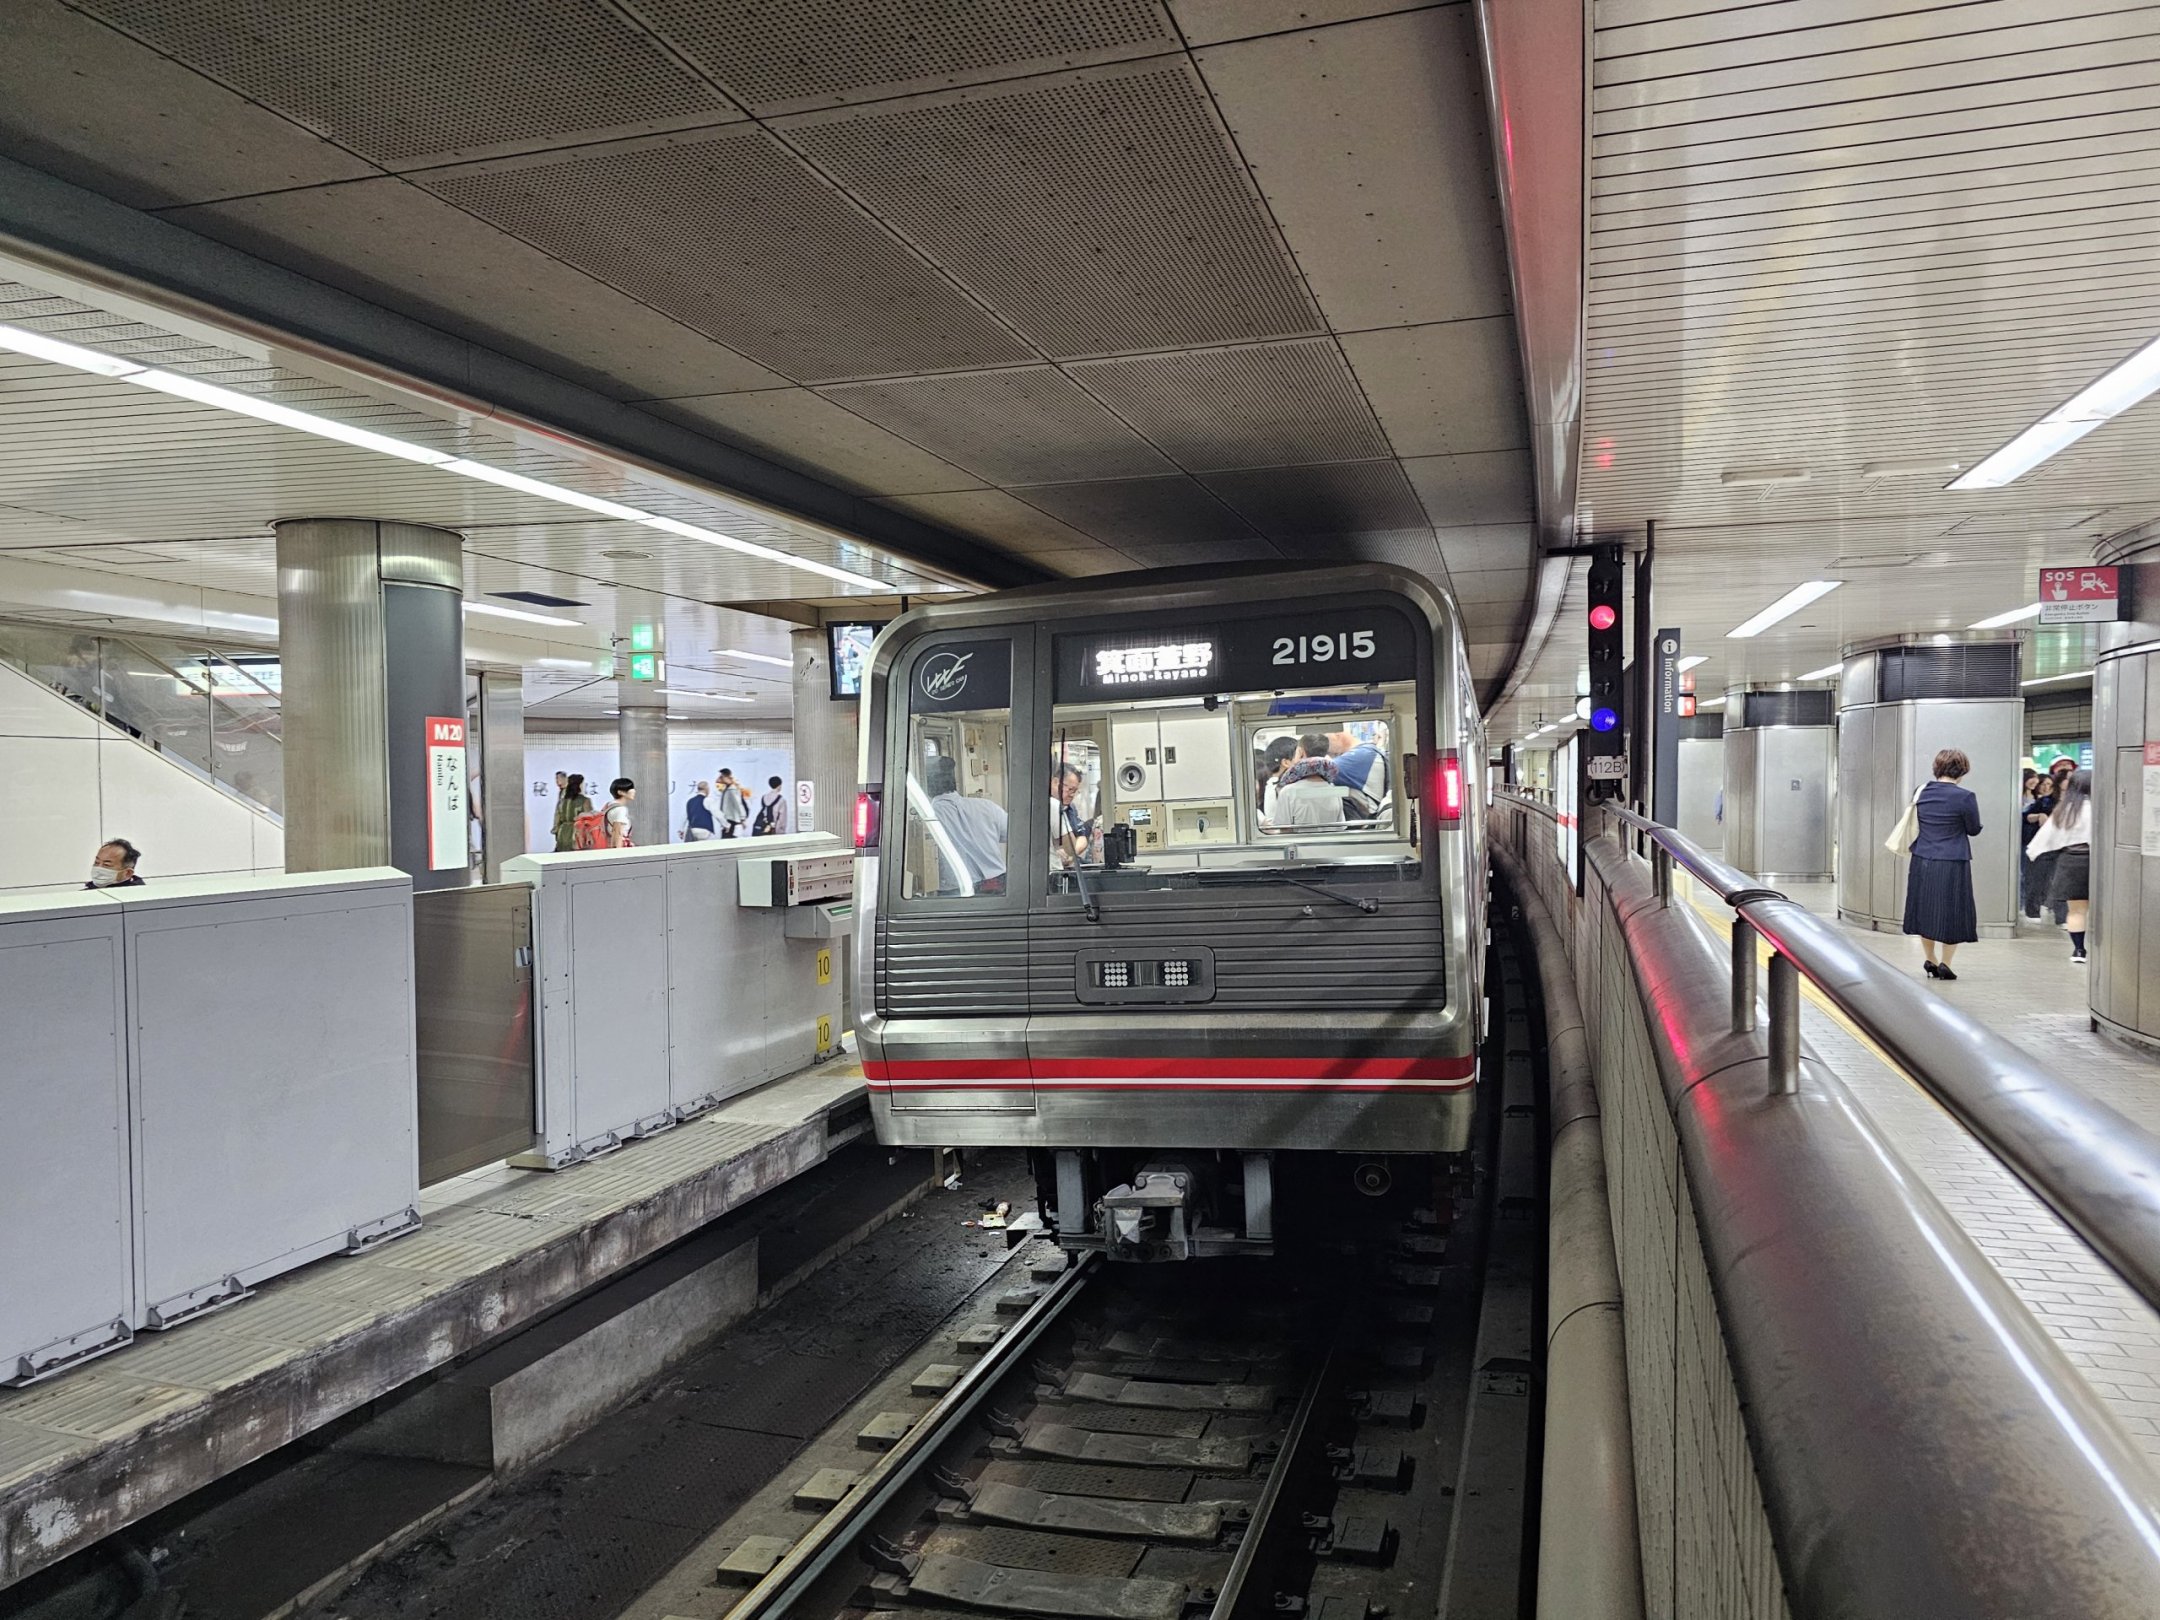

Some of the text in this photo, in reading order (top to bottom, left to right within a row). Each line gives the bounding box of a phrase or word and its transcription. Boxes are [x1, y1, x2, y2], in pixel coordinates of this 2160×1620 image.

[2045, 571, 2075, 582] SOS
[1272, 630, 1375, 665] 21915
[1664, 657, 1674, 713] Information
[434, 724, 463, 741] M20
[1590, 761, 1625, 774] (112B)
[446, 756, 459, 811] なんば
[818, 955, 830, 977] 10
[818, 1022, 830, 1044] 10
